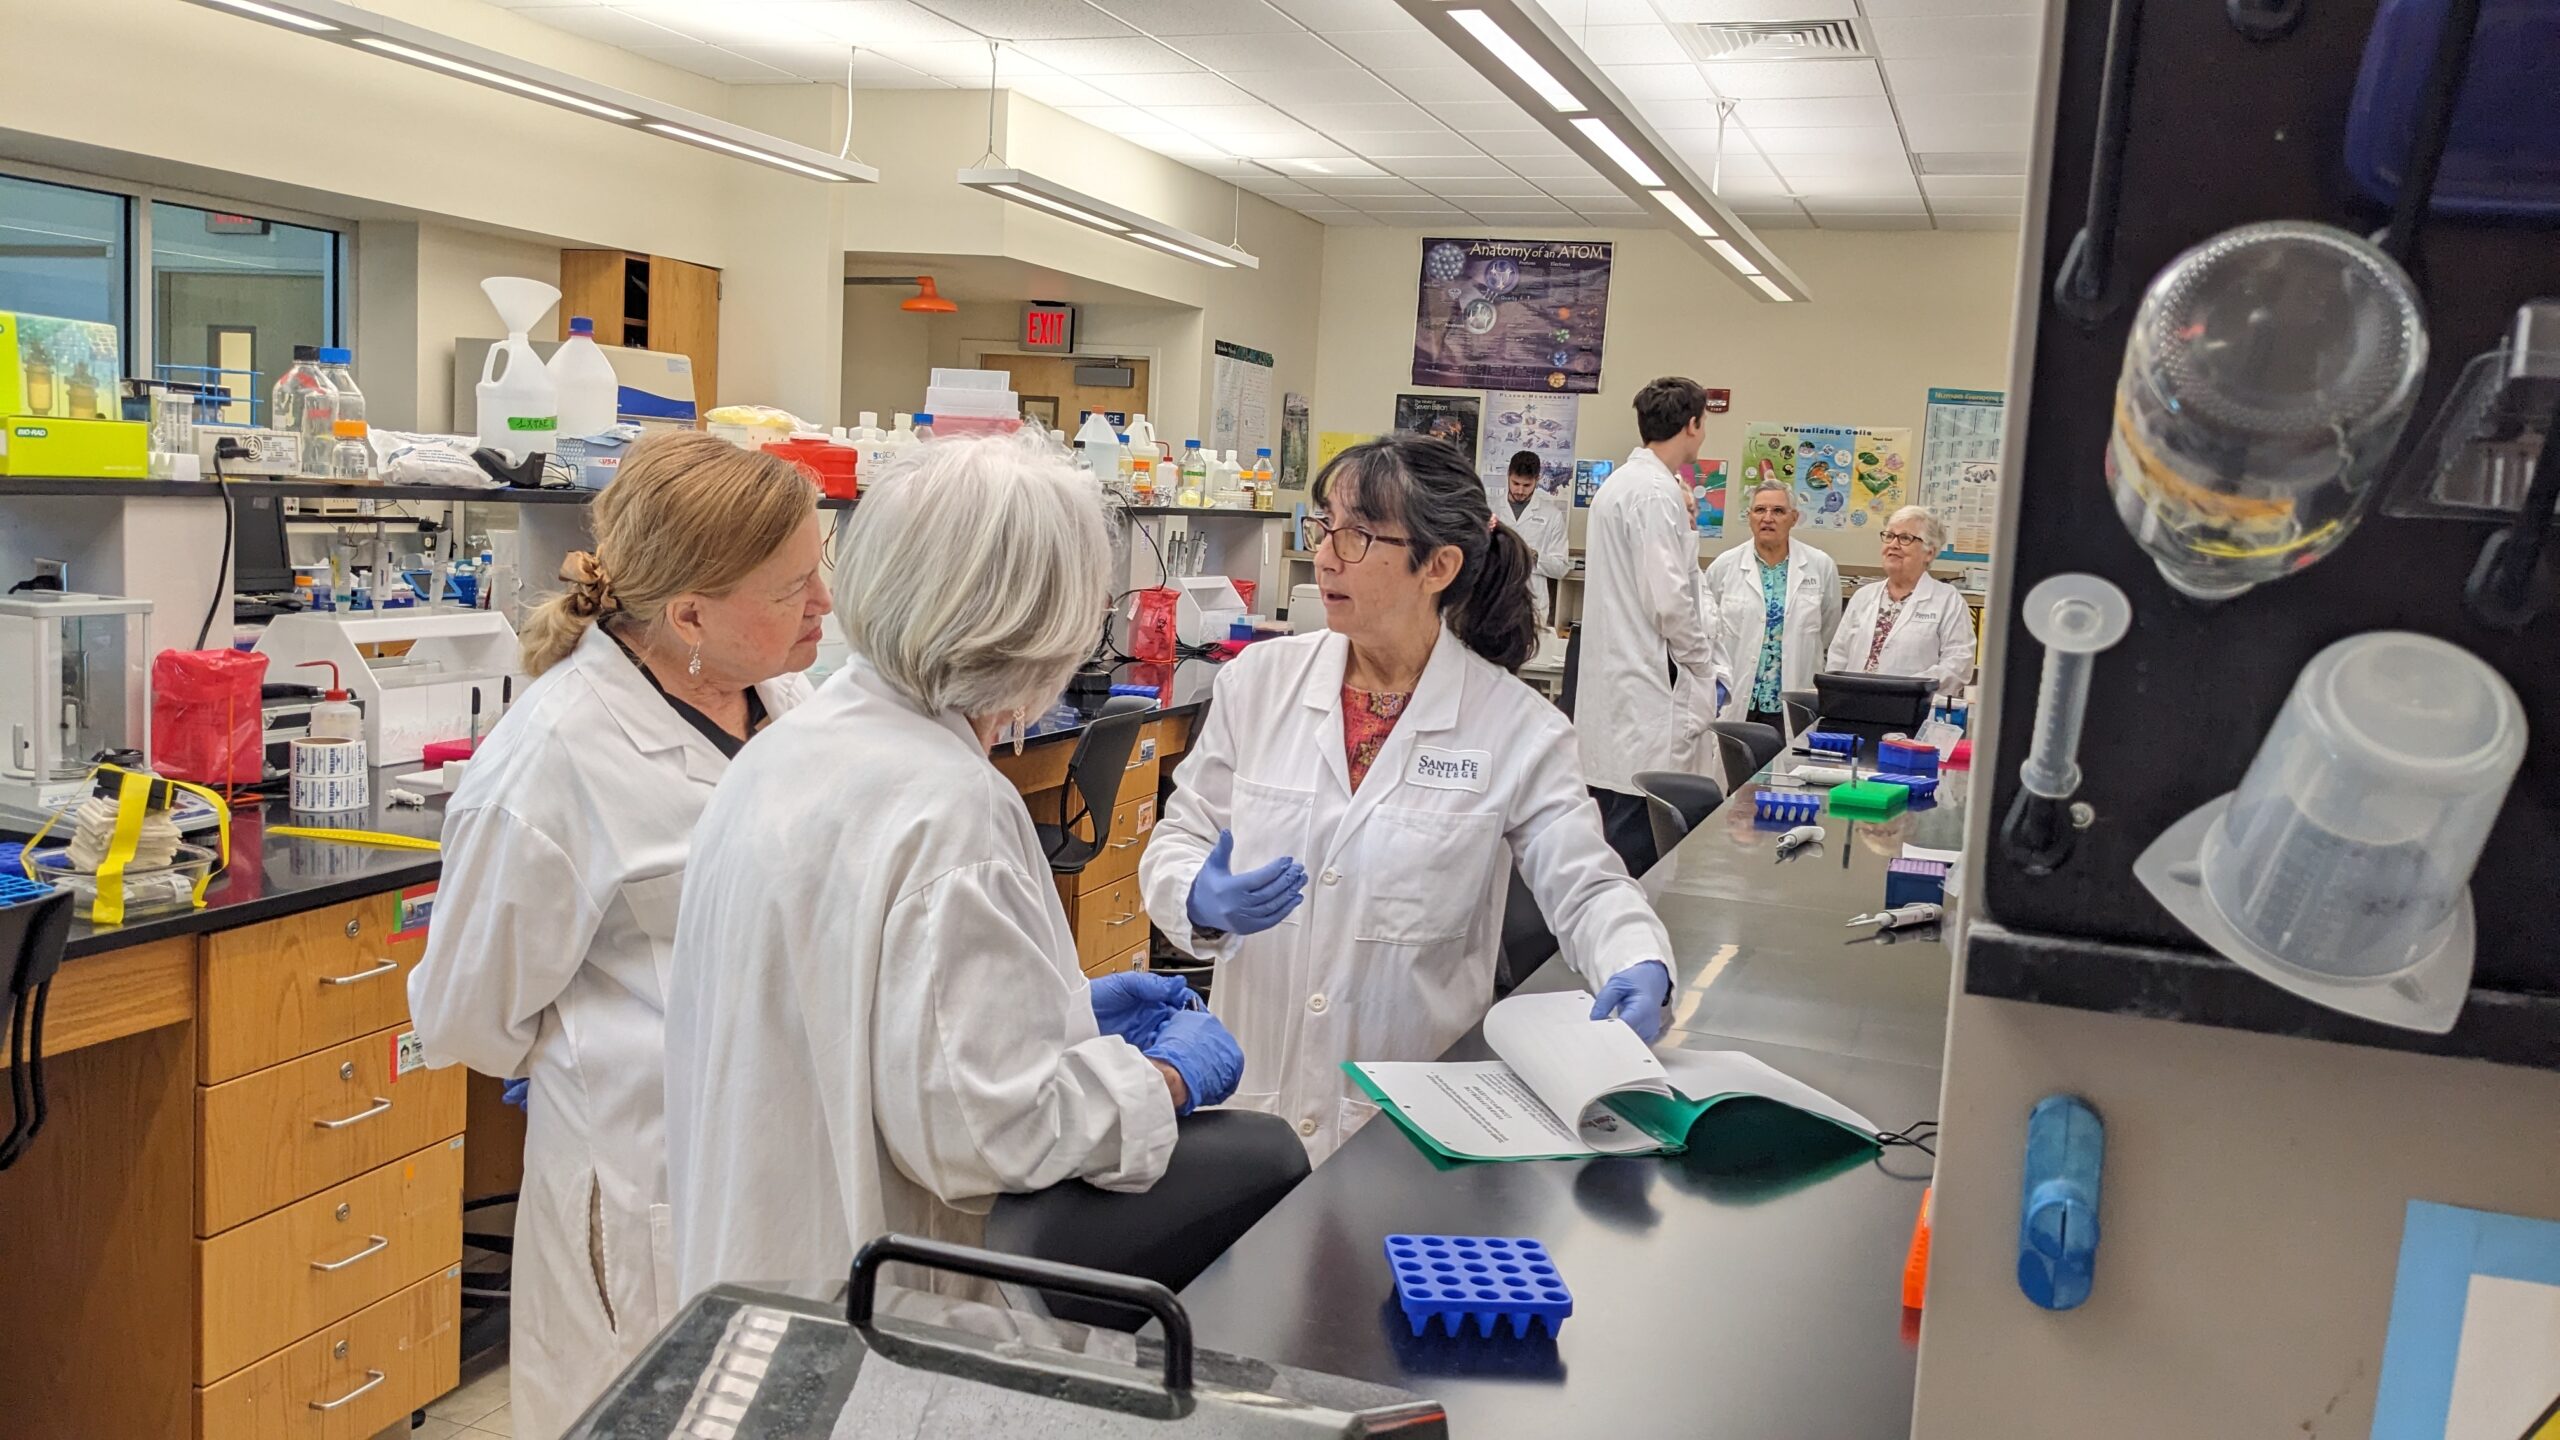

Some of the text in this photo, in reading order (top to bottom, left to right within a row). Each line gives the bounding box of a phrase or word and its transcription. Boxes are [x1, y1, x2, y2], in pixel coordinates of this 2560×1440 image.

[1469, 242, 1603, 261] Anatomy of an ATOM
[1028, 312, 1065, 345] EXIT
[17, 428, 46, 437] BIO-RAD
[1783, 426, 1872, 436] Visualizing Cells
[1418, 755, 1479, 772] SANTA FE
[1418, 767, 1478, 780] COLLEGE
